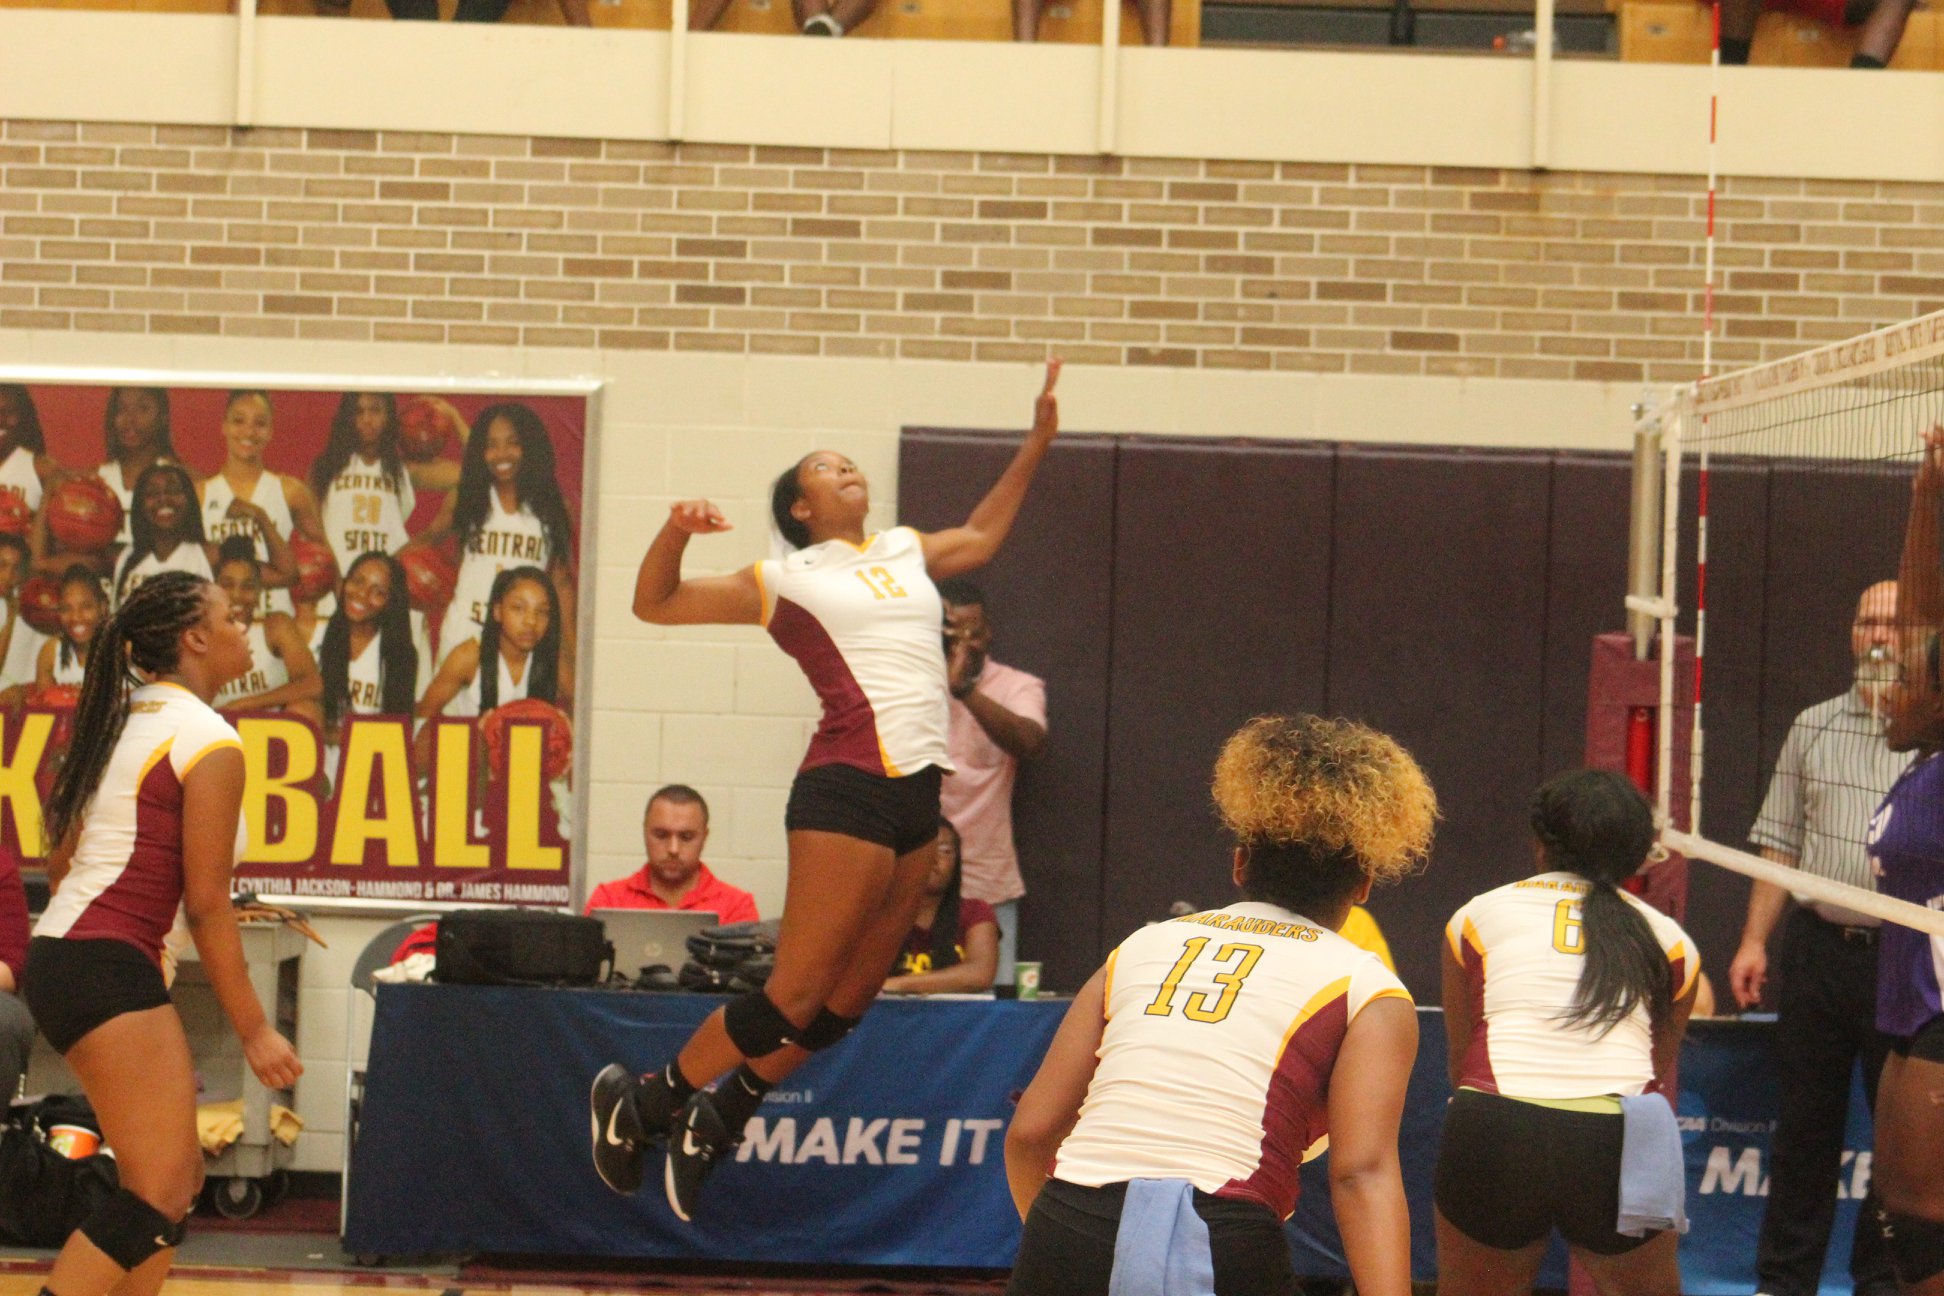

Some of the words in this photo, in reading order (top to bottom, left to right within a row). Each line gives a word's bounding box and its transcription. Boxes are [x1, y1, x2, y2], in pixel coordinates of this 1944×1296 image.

[855, 566, 908, 601] 12
[461, 882, 502, 900] JAMES
[503, 884, 569, 903] HAMMOND
[1552, 898, 1586, 956] 6
[1144, 935, 1265, 1024] 13
[735, 1116, 926, 1165] MAKE
[938, 1118, 1003, 1166] IT
